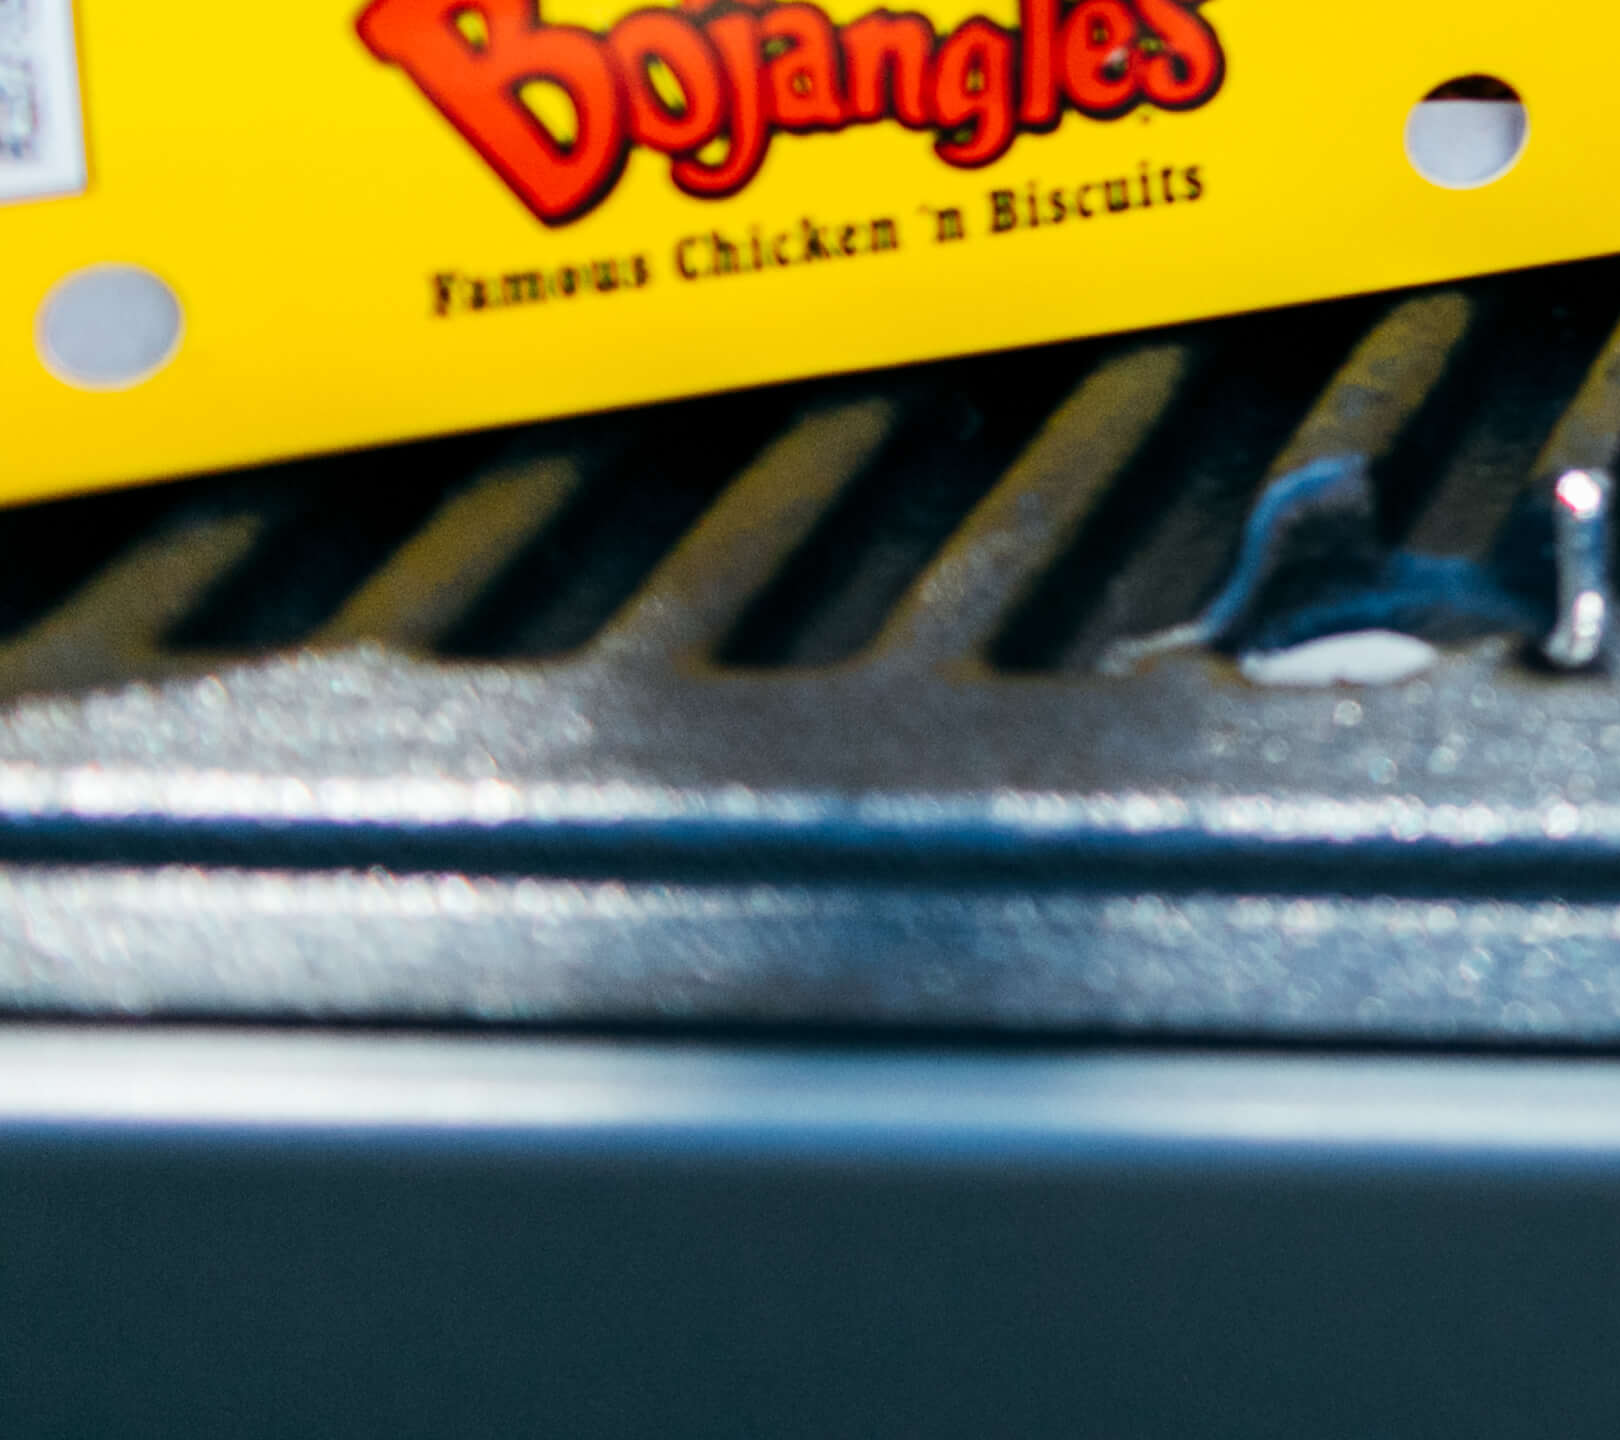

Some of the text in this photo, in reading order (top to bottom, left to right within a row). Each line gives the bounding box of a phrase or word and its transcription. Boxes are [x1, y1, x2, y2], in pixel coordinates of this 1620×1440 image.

[428, 252, 649, 319] Famous
[676, 207, 899, 283] Chicken
[988, 162, 1205, 236] Biscuits
